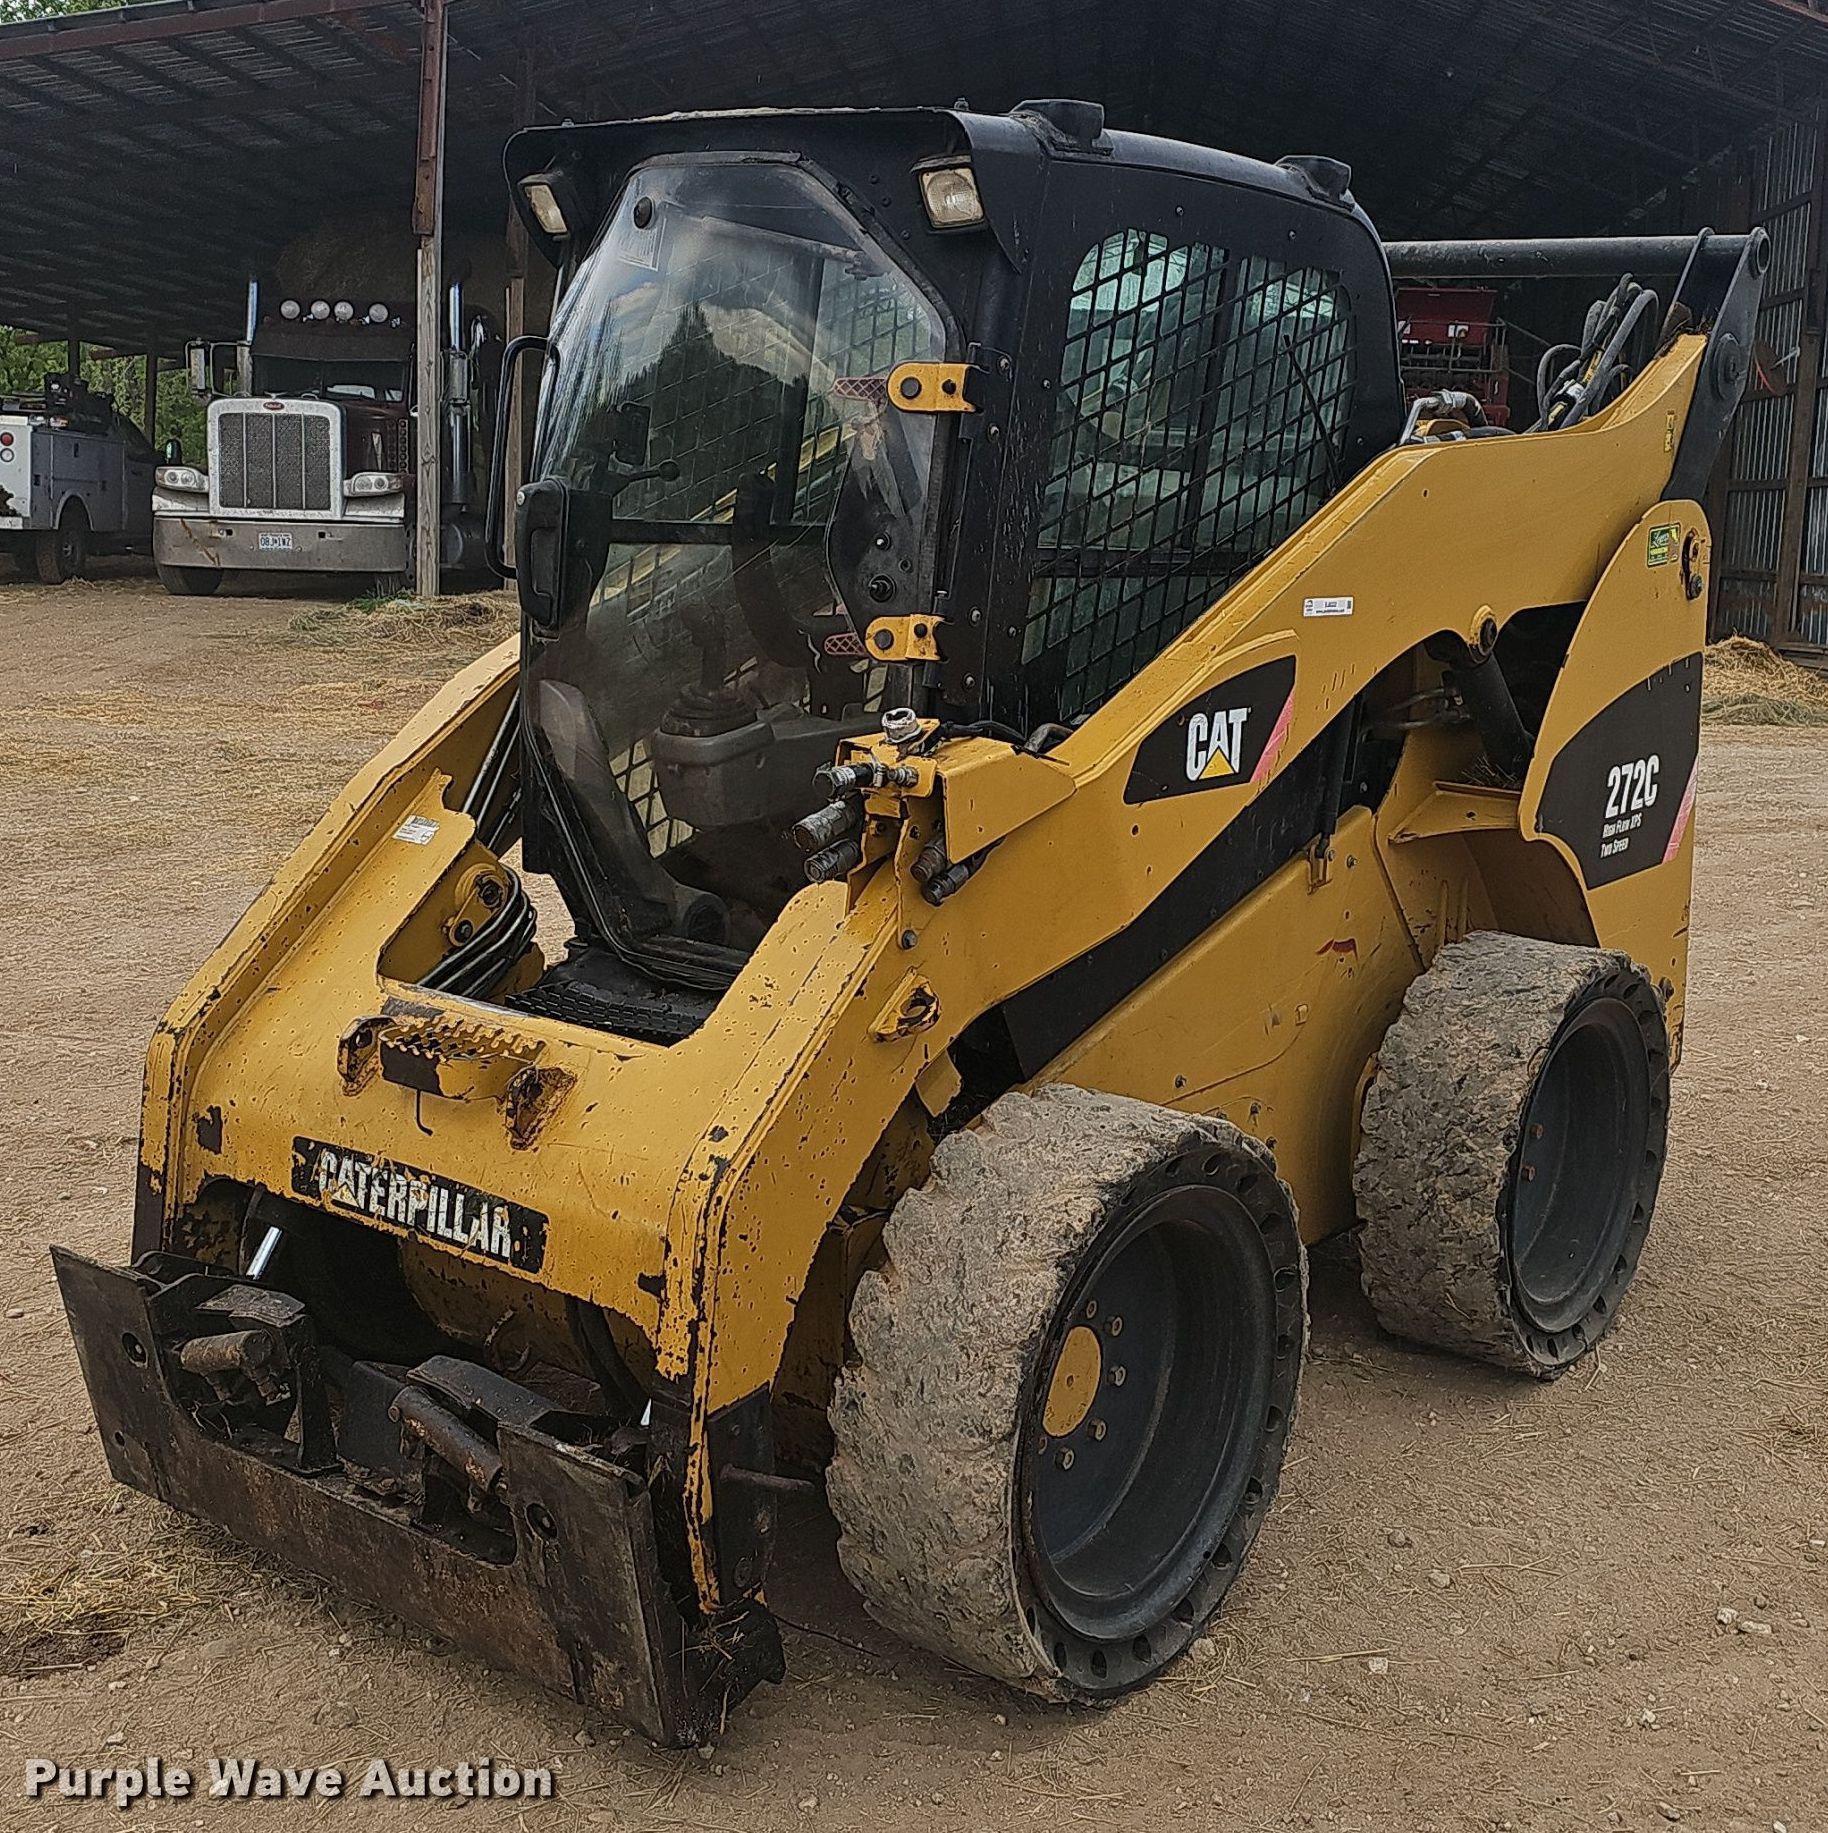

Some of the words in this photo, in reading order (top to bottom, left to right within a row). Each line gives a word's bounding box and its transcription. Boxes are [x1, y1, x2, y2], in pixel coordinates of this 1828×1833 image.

[1186, 707, 1248, 782] CAT
[1605, 754, 1660, 819] 272C
[319, 1150, 512, 1259] CATERPILLAR
